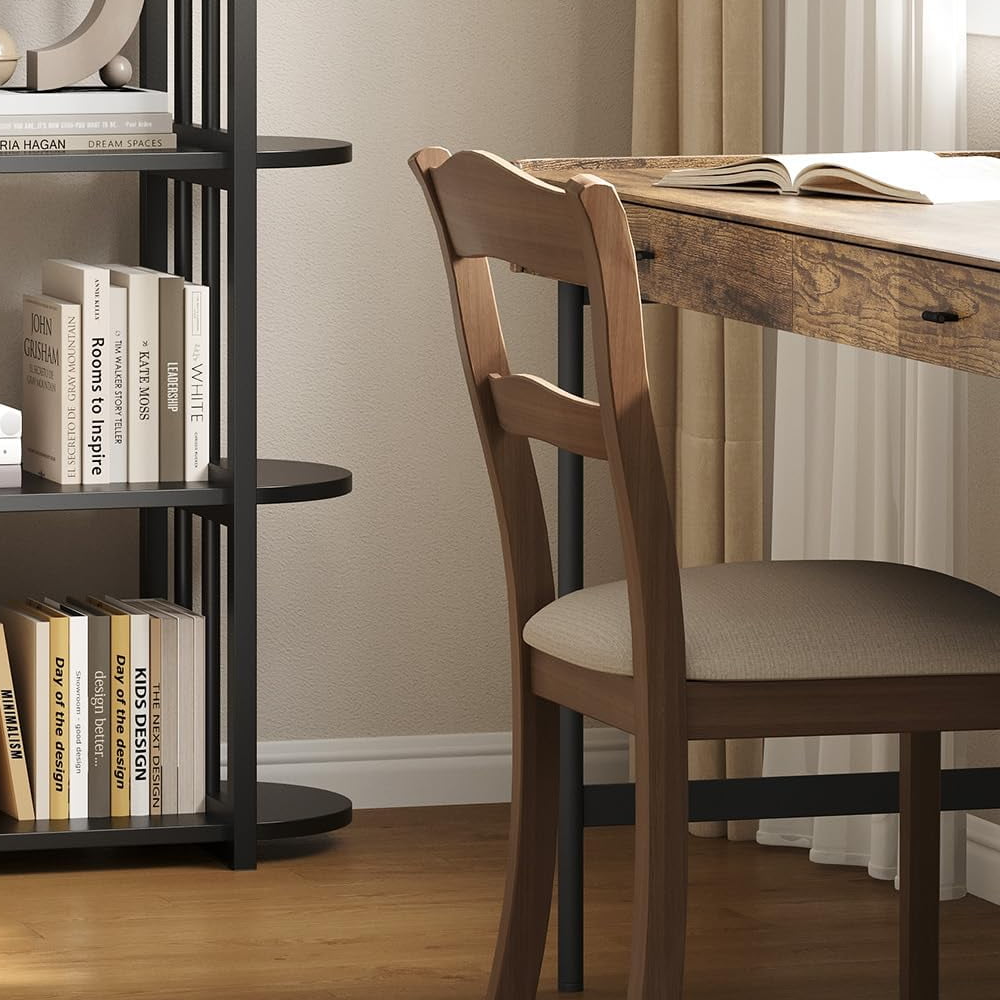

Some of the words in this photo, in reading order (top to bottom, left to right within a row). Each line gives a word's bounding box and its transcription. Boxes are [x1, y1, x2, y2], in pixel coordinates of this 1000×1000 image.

[24, 139, 66, 150] HAGAN
[88, 140, 122, 148] DREAM
[127, 139, 162, 148] SPACES
[31, 313, 52, 336] JOHN
[24, 338, 60, 366] GRISHAM
[68, 316, 76, 373] MOUNTAIN
[114, 340, 122, 354] TIM
[92, 337, 104, 392] Rooms
[114, 356, 122, 389] WALKER
[139, 351, 150, 384] KATE
[68, 374, 76, 402] GRAY
[114, 390, 122, 416] STORY
[139, 386, 150, 420] MOSS
[167, 362, 178, 413] LEADERSHIP
[190, 363, 204, 423] WHITE
[68, 406, 76, 420] DE
[92, 398, 104, 414] to
[68, 421, 76, 465] SECRETO
[114, 418, 122, 444] TELLER
[88, 420, 106, 476] Inspire
[68, 468, 76, 478] EL
[54, 656, 65, 686] Day
[114, 654, 126, 684] Day
[56, 691, 65, 708] of
[90, 670, 106, 714] design
[116, 688, 126, 706] of
[135, 668, 147, 710] KIDS
[152, 683, 160, 710] THE
[0, 690, 24, 760] MINIMALISM
[56, 712, 65, 736] the
[116, 708, 126, 734] the
[152, 714, 160, 751] NEXT
[94, 718, 106, 767] better...
[135, 714, 147, 781] DESIGN
[53, 741, 65, 792] design
[114, 738, 126, 790] design
[152, 756, 160, 808] DESIGN
